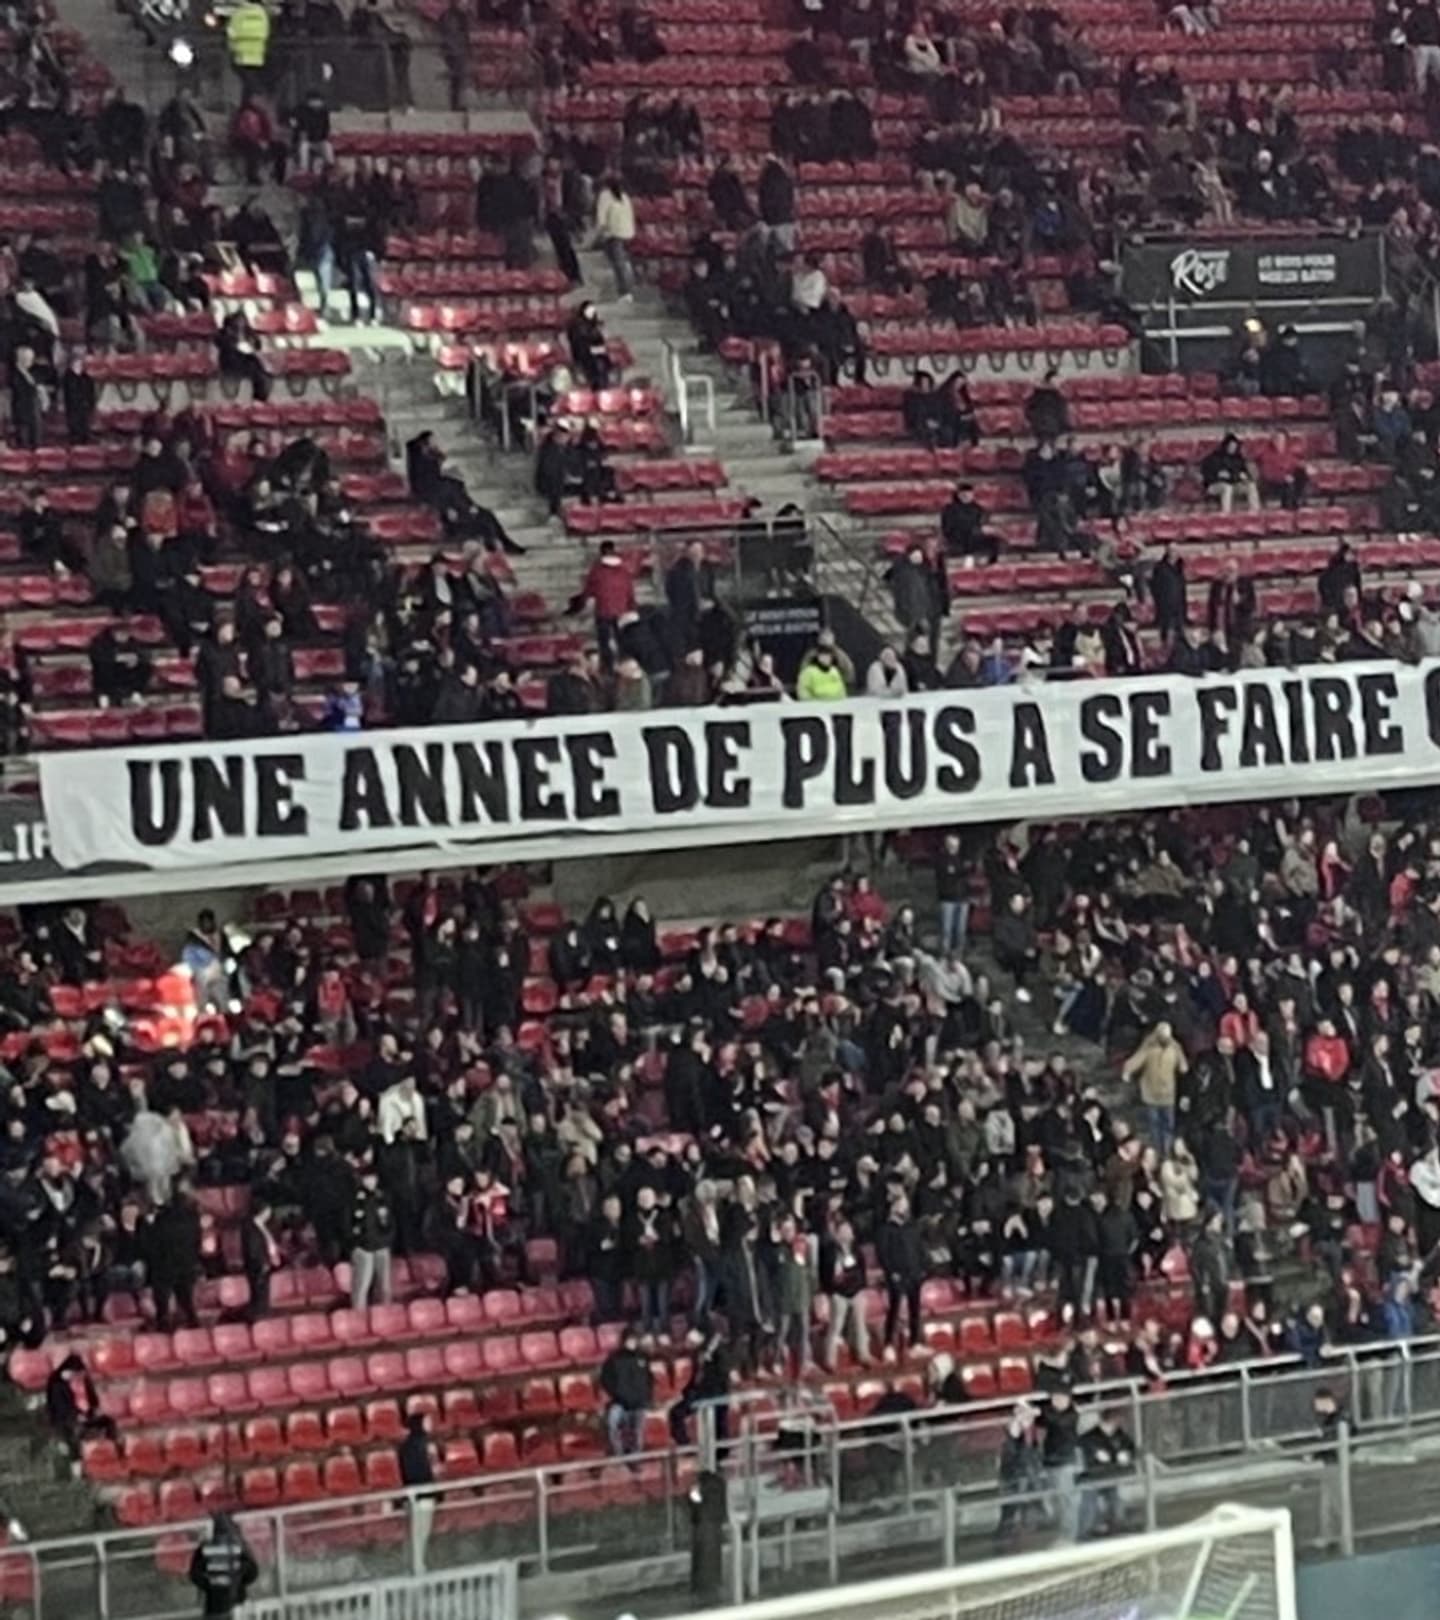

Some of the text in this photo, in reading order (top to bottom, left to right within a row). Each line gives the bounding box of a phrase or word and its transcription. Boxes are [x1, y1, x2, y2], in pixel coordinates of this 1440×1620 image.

[127, 753, 308, 846] UNE
[339, 732, 622, 831] ANNEE
[641, 720, 752, 814] DE
[780, 706, 982, 809] PLUS
[1009, 702, 1056, 788] A
[1079, 690, 1172, 783] SE
[1196, 673, 1404, 772] FAIRE
